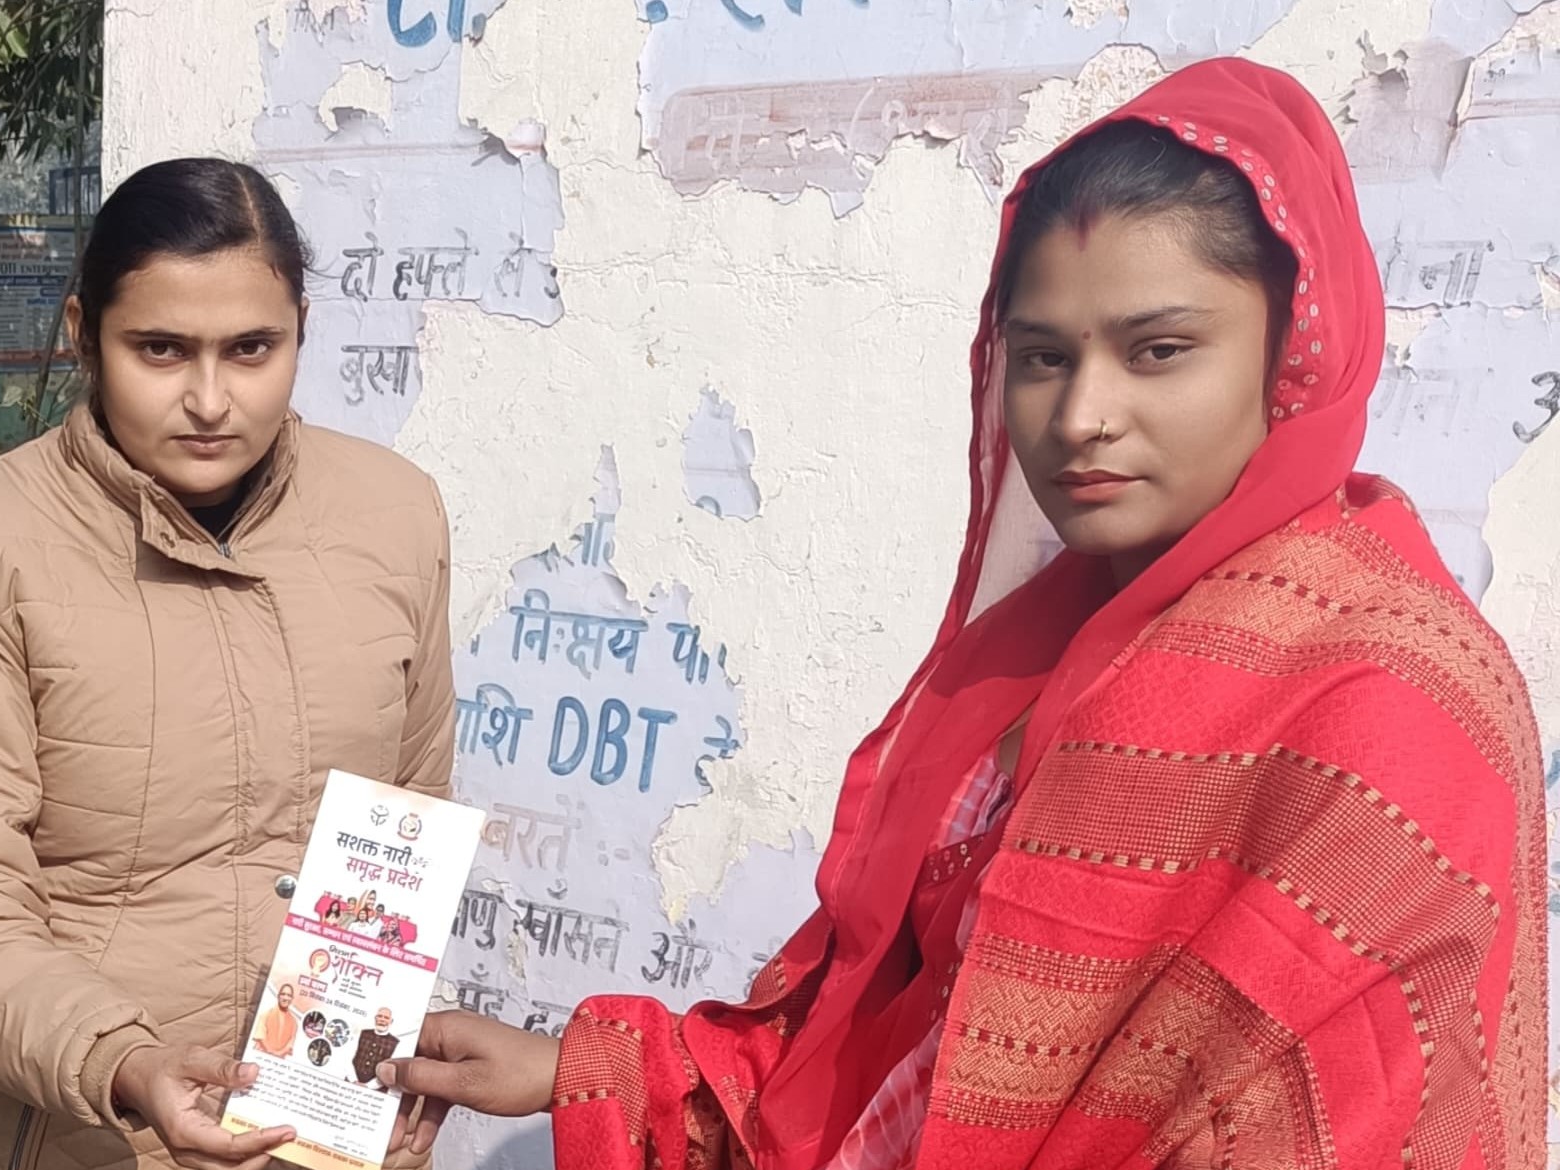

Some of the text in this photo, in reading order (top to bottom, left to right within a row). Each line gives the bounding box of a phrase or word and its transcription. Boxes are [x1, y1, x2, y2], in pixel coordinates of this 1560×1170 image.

[340, 345, 420, 406] बुखा
[547, 695, 678, 794] DBT
[336, 831, 412, 867] सशक्त नारी
[386, 867, 423, 892] प्रदेश
